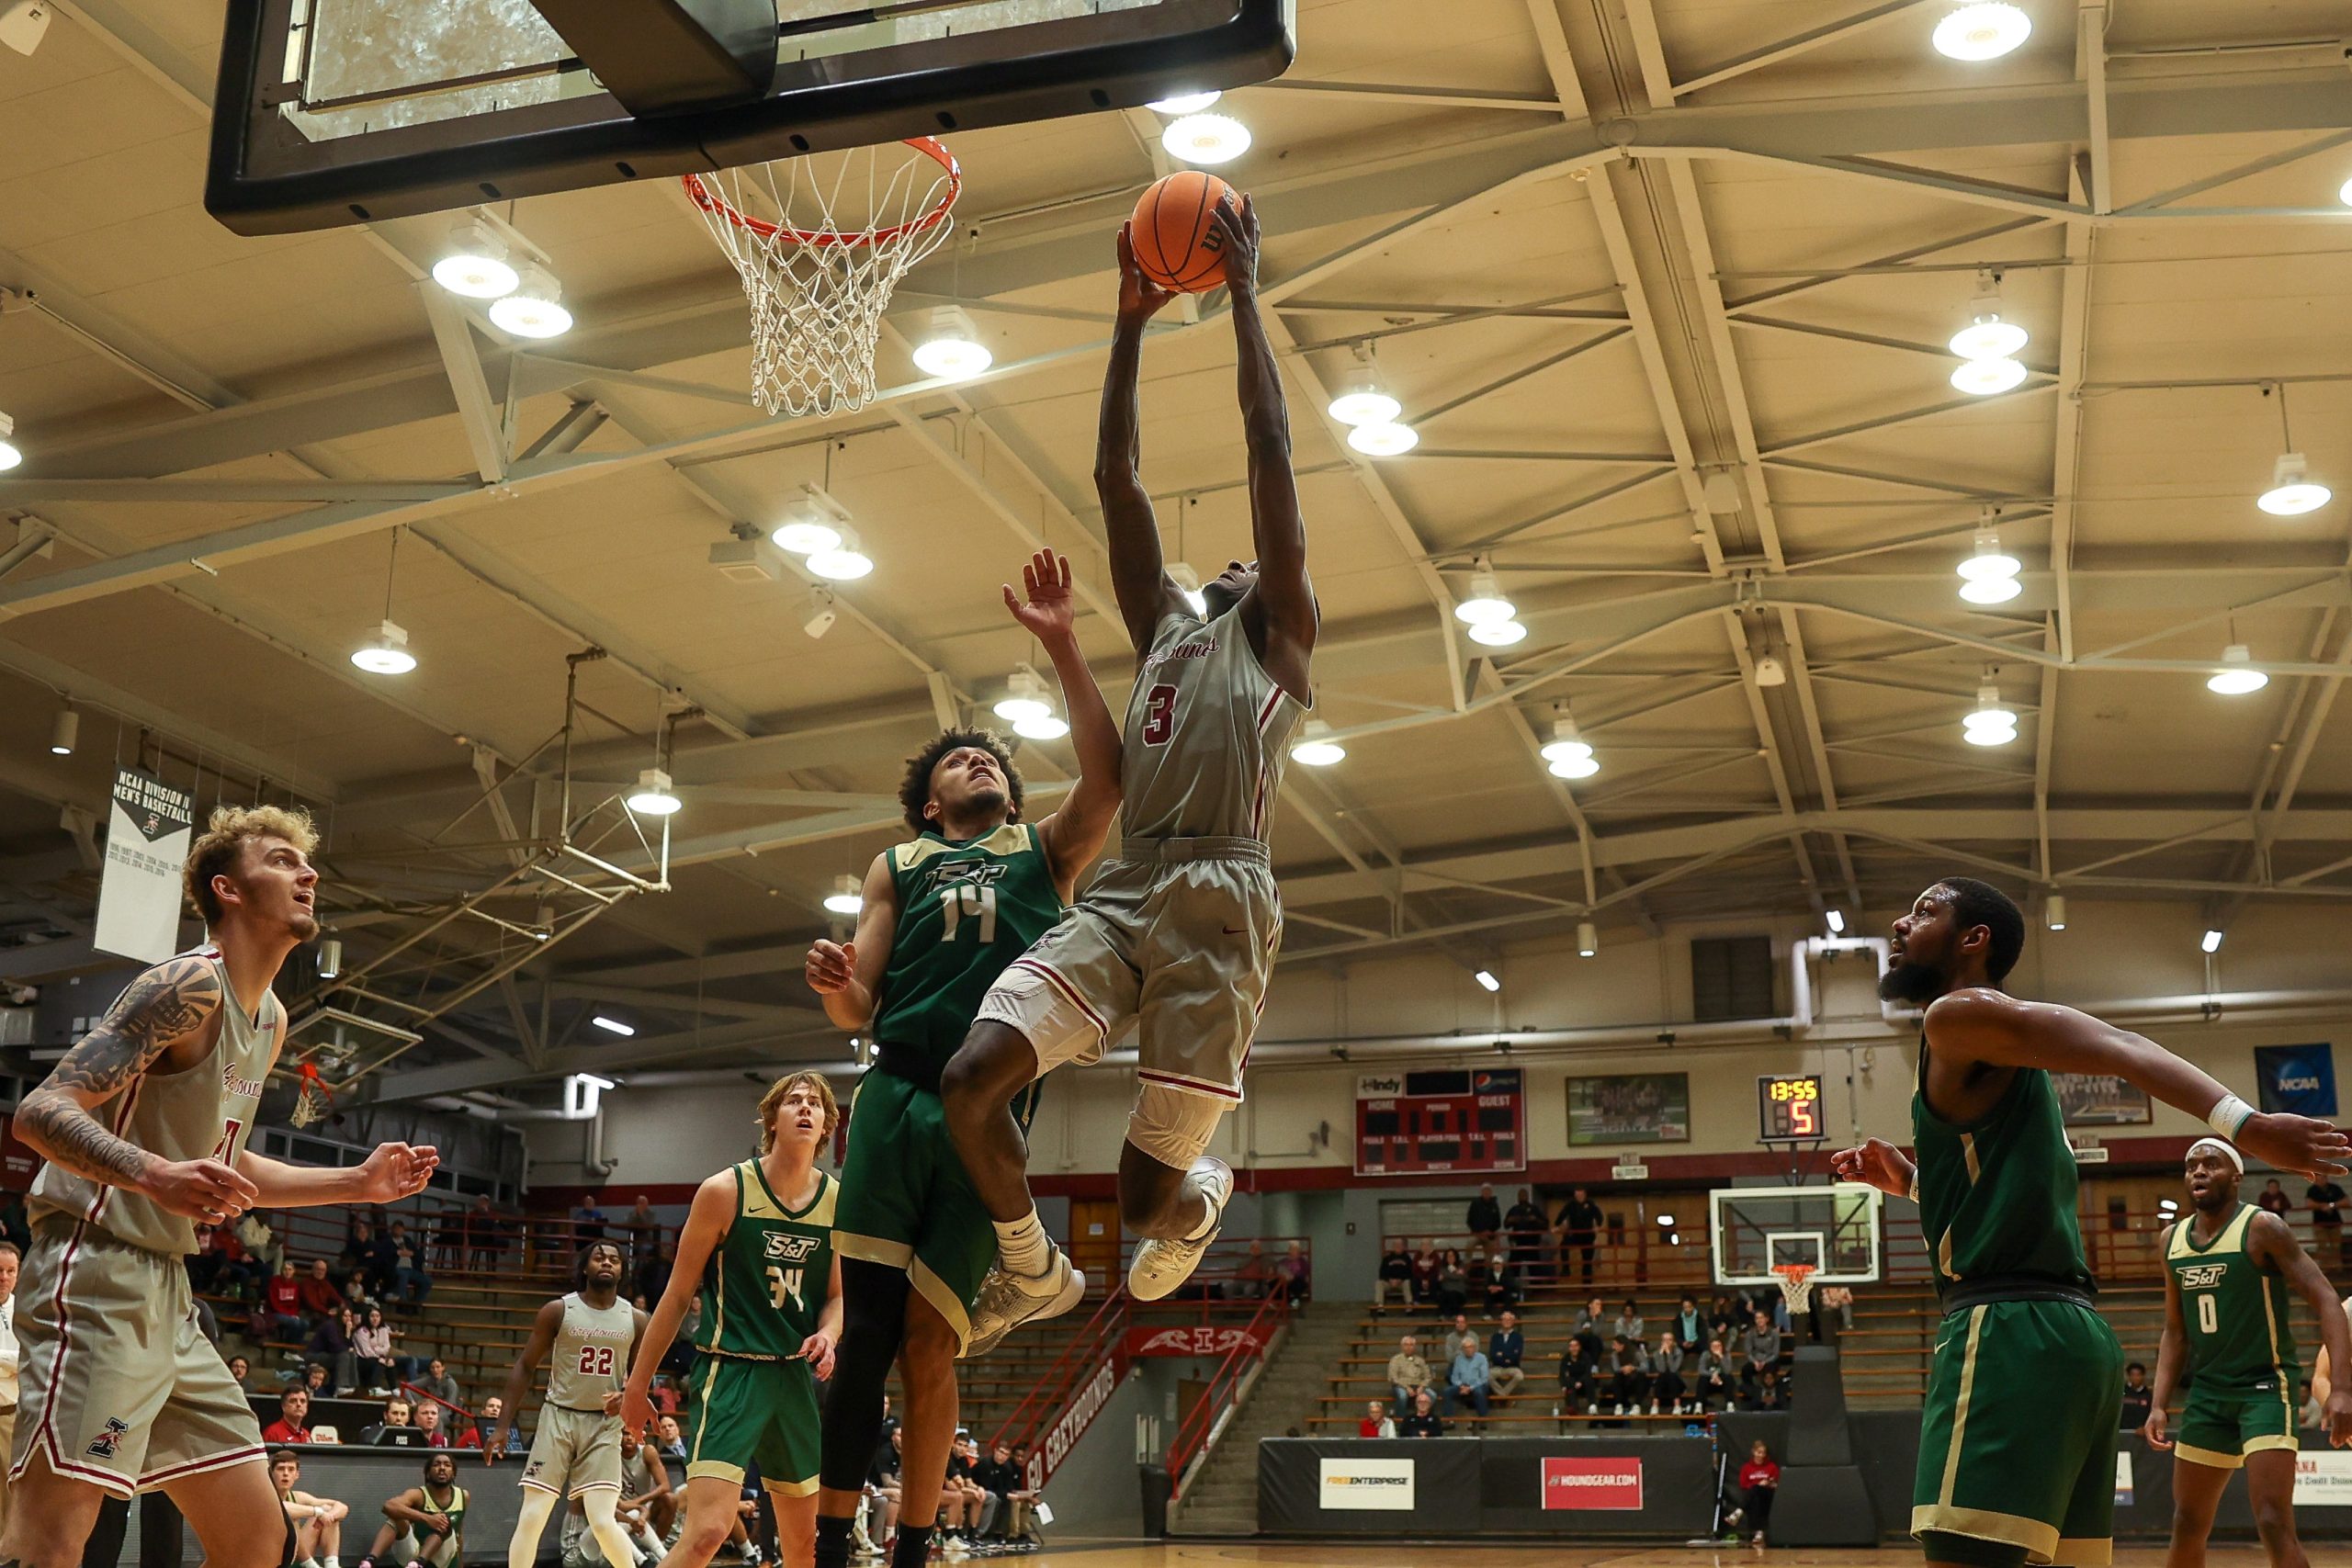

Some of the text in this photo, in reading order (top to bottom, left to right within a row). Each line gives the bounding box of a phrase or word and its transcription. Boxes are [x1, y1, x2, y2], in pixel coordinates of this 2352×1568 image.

[1143, 683, 1178, 748] 3
[113, 783, 192, 825] MEN'S BASKETBALL
[119, 770, 190, 810] NCAA DIVISION II
[940, 885, 997, 943] 14
[1770, 1079, 1817, 1101] 13:55
[2278, 1076, 2320, 1091] NCAA
[1478, 1094, 1510, 1108] GUEST
[1792, 1100, 1815, 1134] 5
[764, 1233, 818, 1260] S&T
[766, 1266, 805, 1313] 34
[2180, 1265, 2225, 1288] S&T
[2199, 1293, 2219, 1334] 0
[568, 1325, 628, 1341] Greyhounds
[578, 1346, 615, 1377] 22
[1027, 1358, 1114, 1491] GO GREYHOUNDS
[1560, 1474, 1637, 1487] HOUNDGEAR.COM
